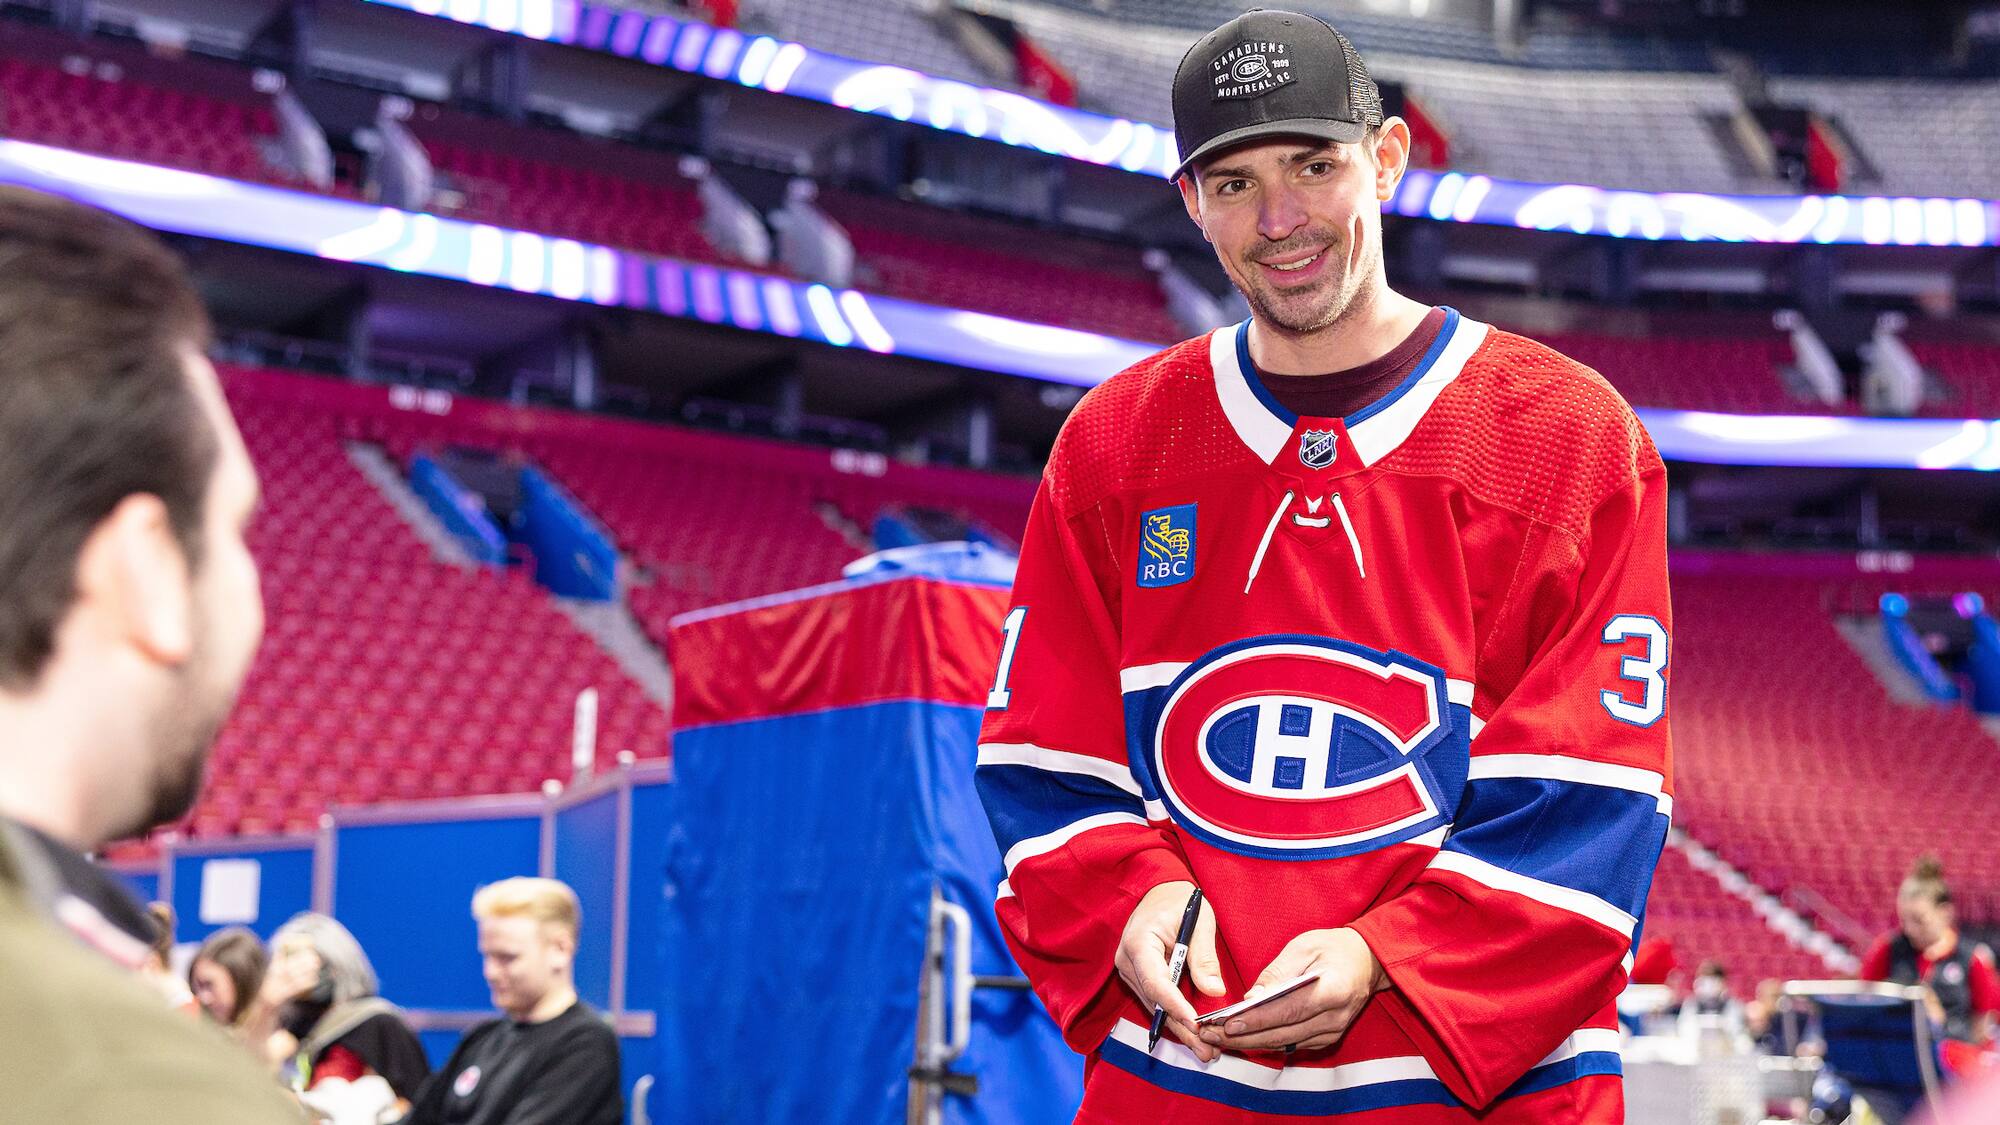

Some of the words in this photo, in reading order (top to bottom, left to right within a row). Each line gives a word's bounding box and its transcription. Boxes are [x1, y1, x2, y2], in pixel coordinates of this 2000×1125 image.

[1214, 42, 1284, 70] CANADIENS
[1276, 72, 1290, 83] QC
[1143, 561, 1186, 580] RBC
[985, 605, 1029, 711] 1
[1600, 613, 1669, 728] 3
